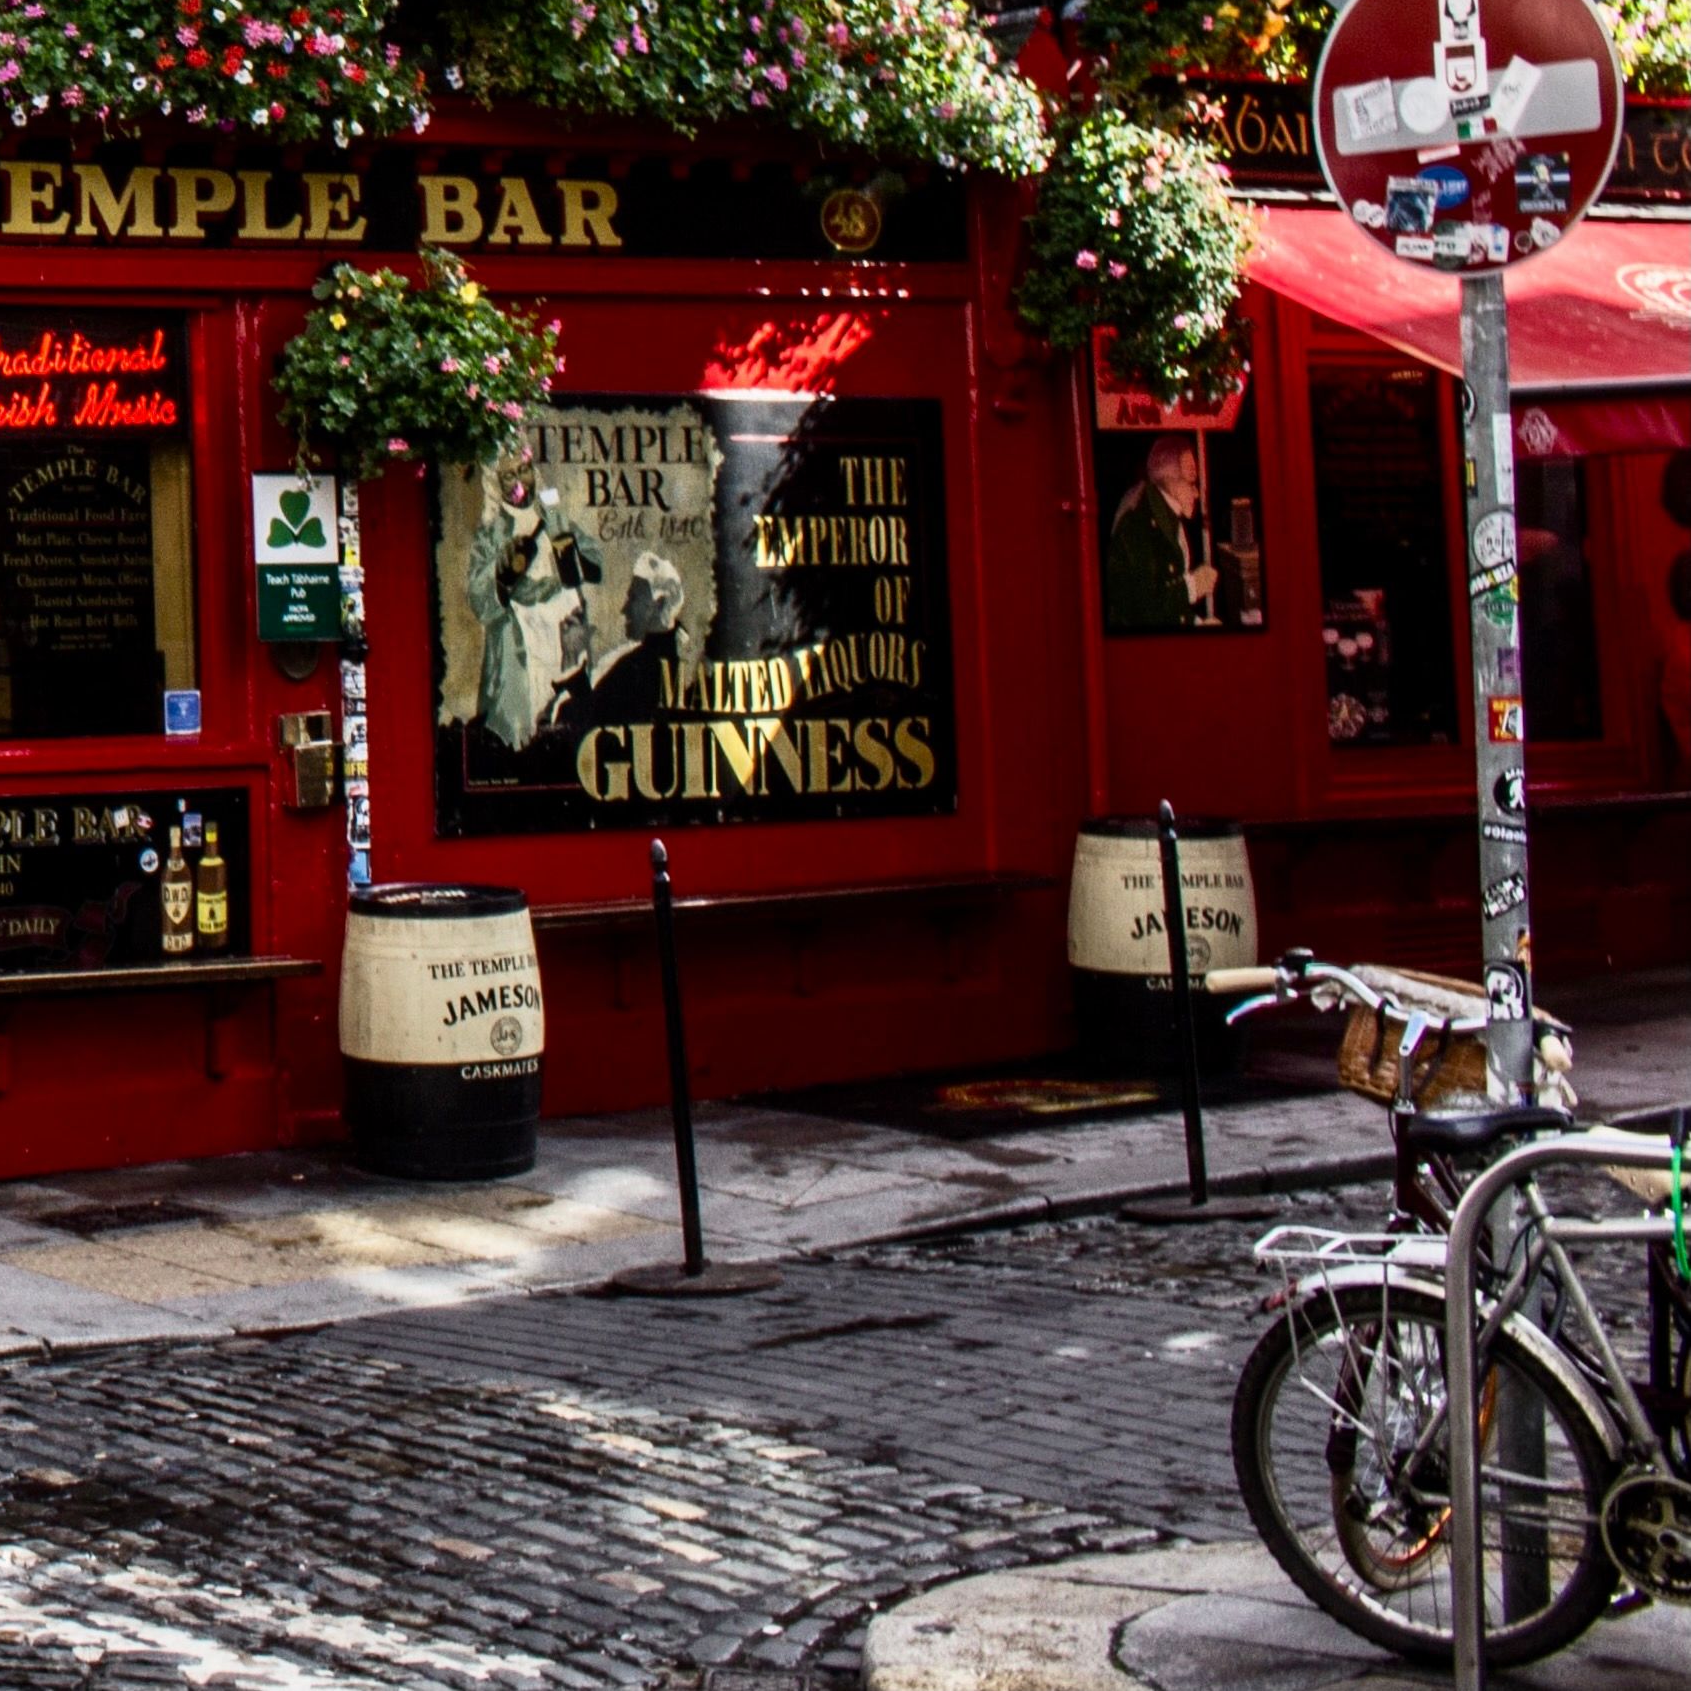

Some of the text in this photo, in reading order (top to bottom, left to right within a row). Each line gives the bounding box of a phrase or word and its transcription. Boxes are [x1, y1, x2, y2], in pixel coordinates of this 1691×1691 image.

[416, 174, 623, 248] BAR
[828, 200, 871, 239] 48
[73, 379, 177, 427] Music
[529, 423, 709, 466] TEMPLE
[7, 458, 147, 506] TEMPLE BAR
[583, 467, 672, 512] BAR
[840, 455, 908, 507] THE
[7, 507, 79, 522] Traditional
[752, 514, 909, 568] EMPEROR
[290, 586, 307, 599] Pub
[874, 576, 910, 625] OF
[658, 630, 927, 714] MALTED LIQUORS
[576, 715, 936, 802] GUINNESS
[72, 804, 149, 844] BAR
[1121, 874, 1155, 890] THE
[8, 917, 61, 940] DAILY
[428, 962, 466, 981] THE
[469, 955, 525, 977] TEMPLE
[443, 983, 541, 1027] JAMESON
[461, 1058, 539, 1080] CASKMATES
